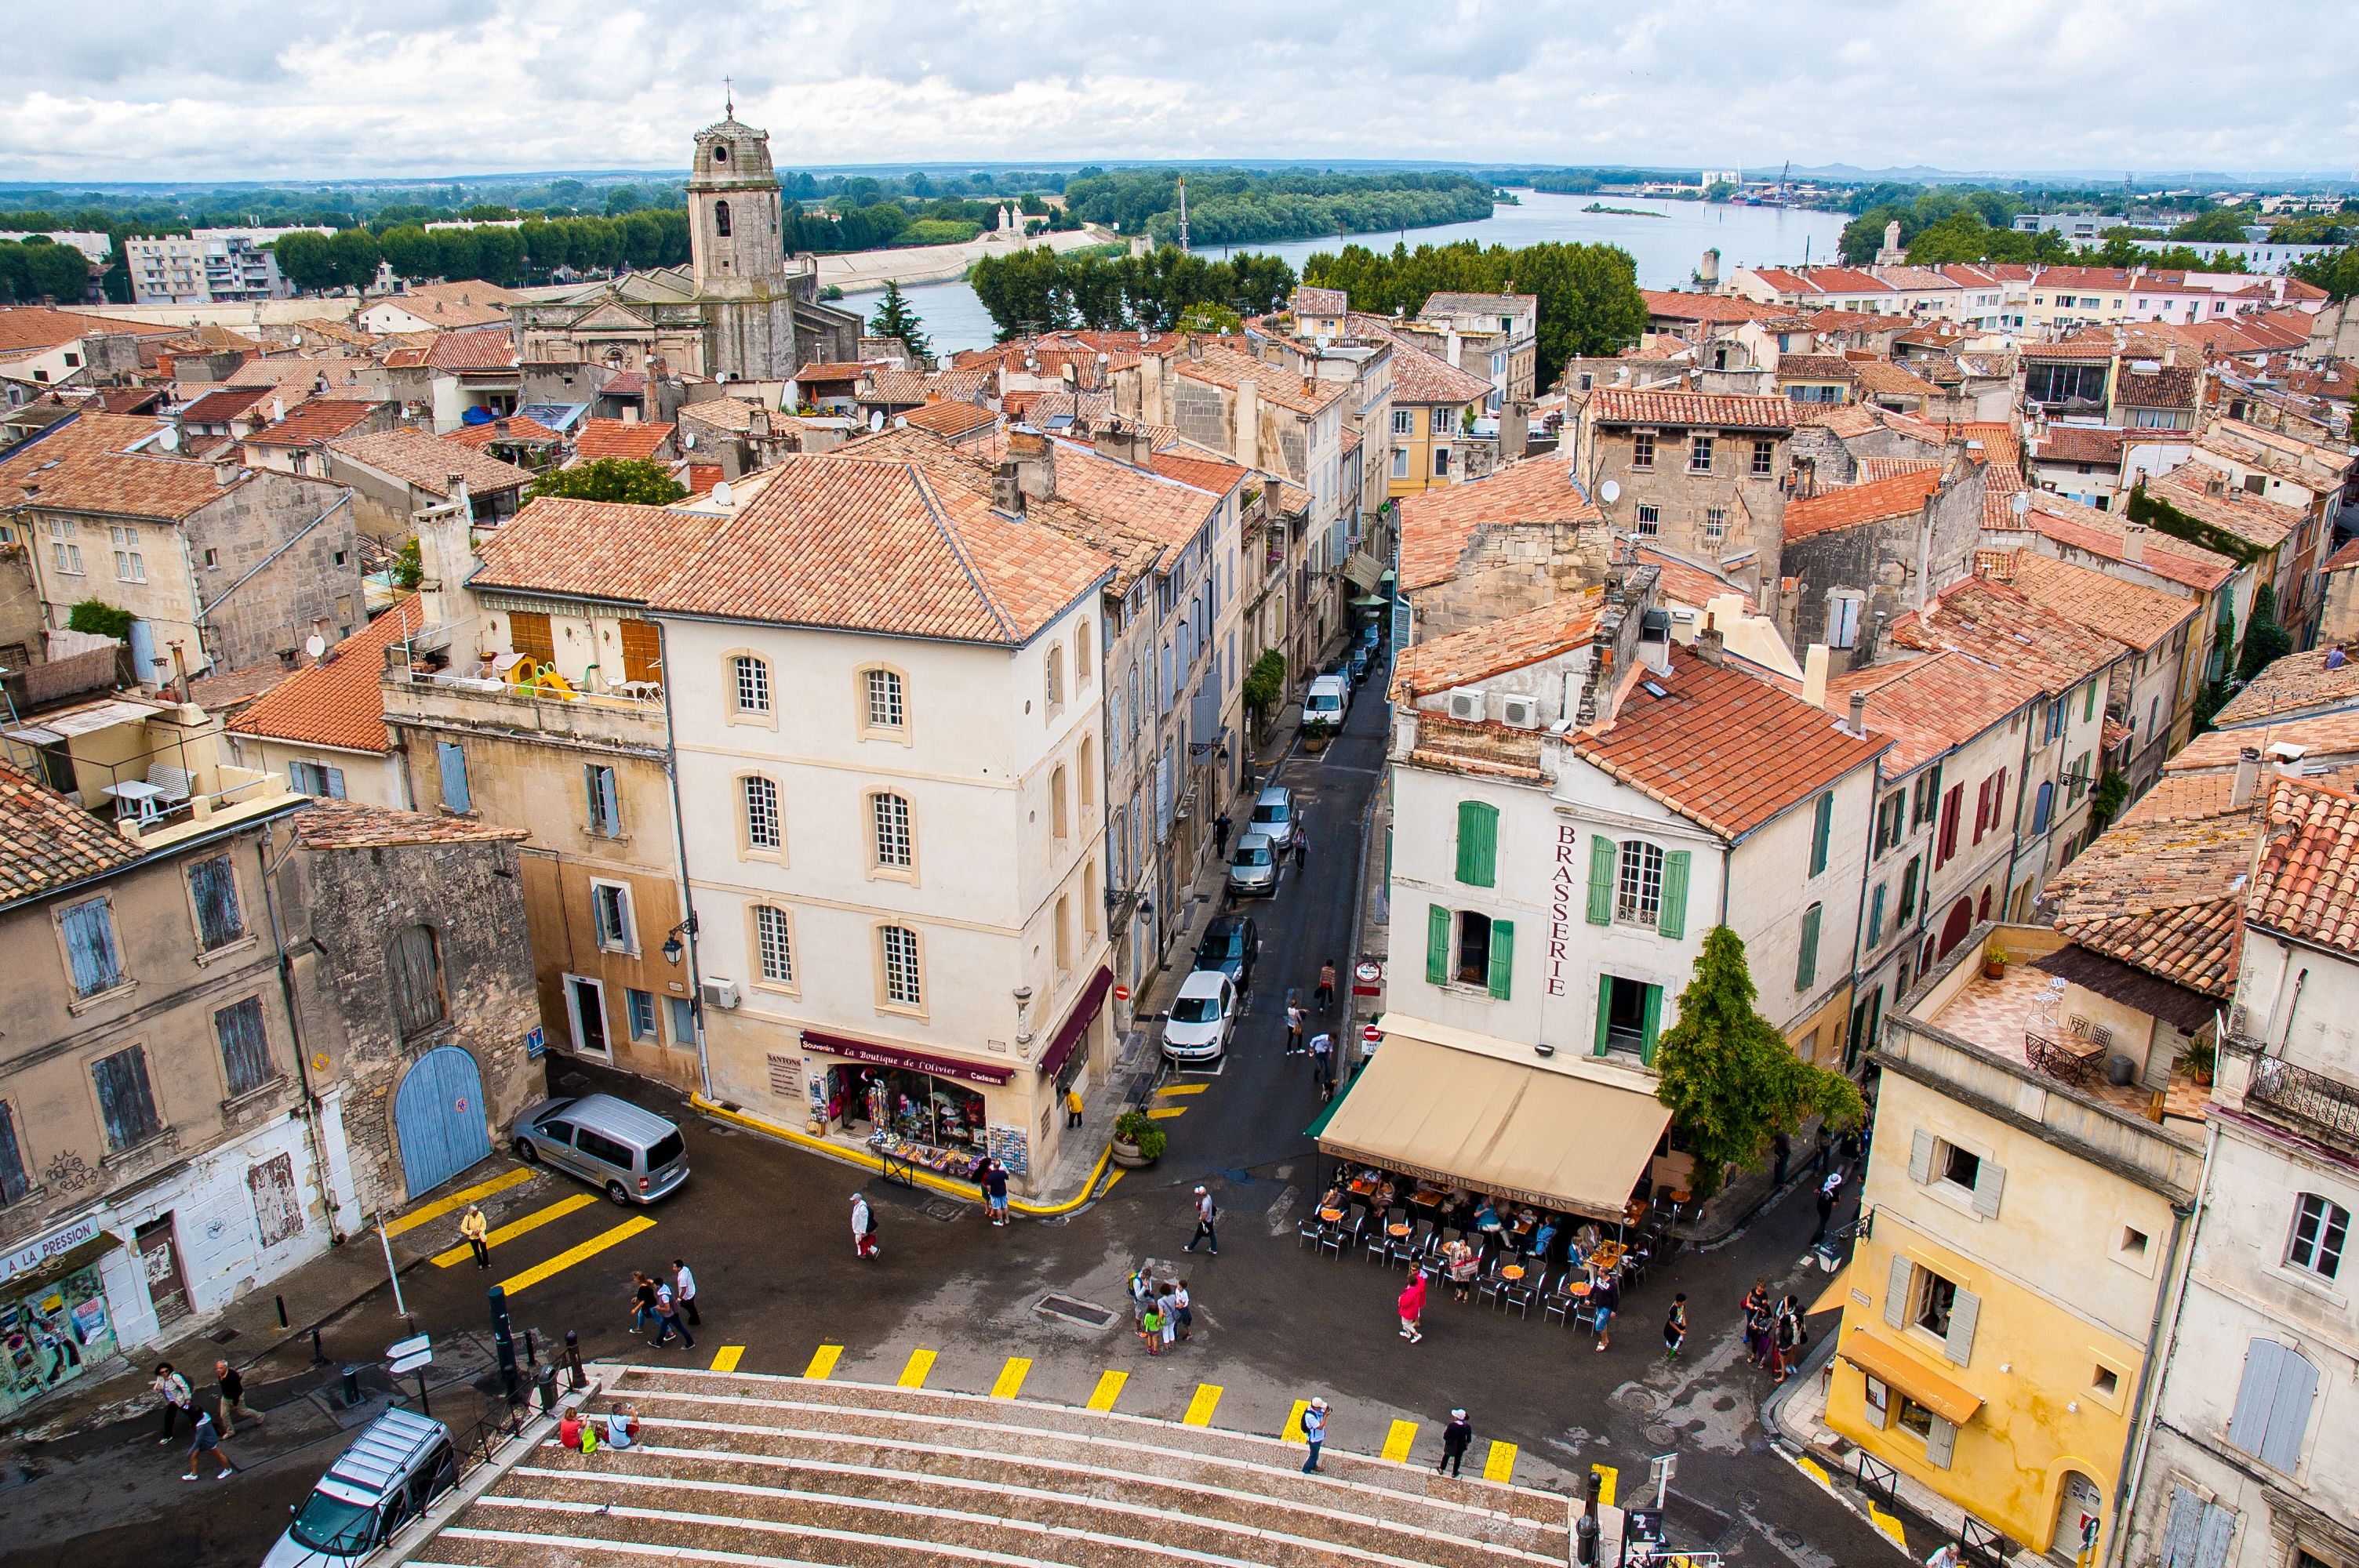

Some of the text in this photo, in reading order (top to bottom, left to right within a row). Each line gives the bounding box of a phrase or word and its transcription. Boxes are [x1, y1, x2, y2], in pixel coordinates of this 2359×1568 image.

[1547, 825, 1576, 997] BRASSERIE
[767, 1054, 801, 1067] SANTONS
[803, 1040, 1001, 1084] Souvenirs La Boutique de l'Olivier Cadeaux
[1380, 1158, 1473, 1189] BRASSERIE
[1485, 1184, 1568, 1210] L'AFICION
[9, 1224, 91, 1274] A LA PRESSION
